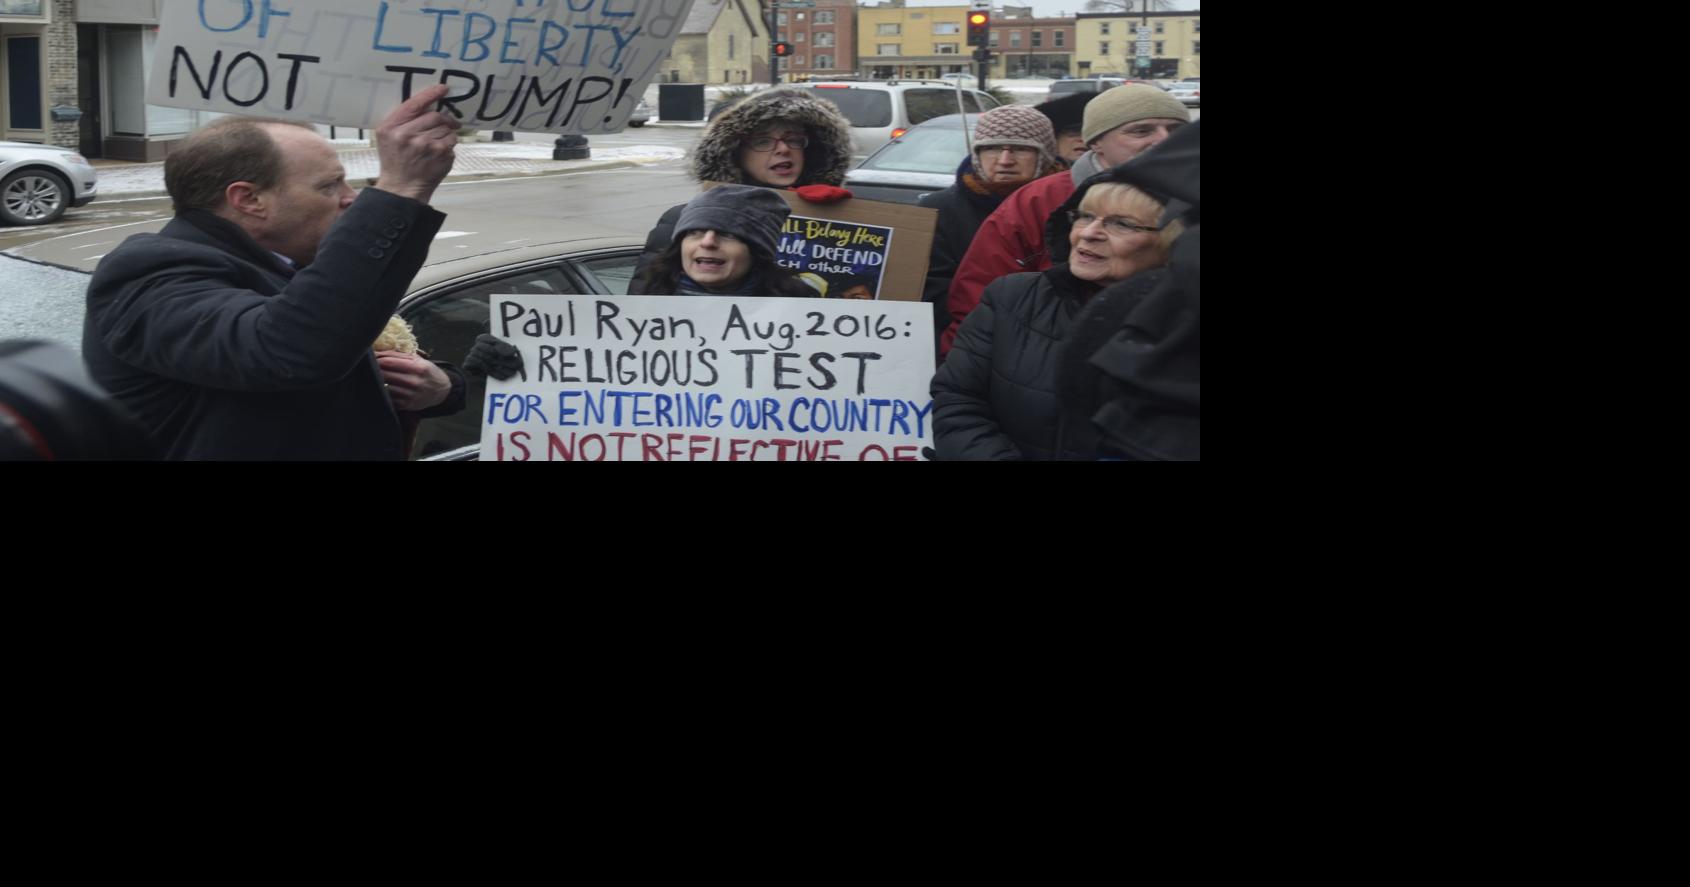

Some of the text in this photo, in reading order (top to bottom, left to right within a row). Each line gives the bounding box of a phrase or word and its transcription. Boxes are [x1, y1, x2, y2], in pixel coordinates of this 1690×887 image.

[169, 45, 320, 110] NOT
[385, 65, 633, 128] TRUMP!
[805, 220, 851, 246] Belong
[500, 300, 575, 338] Paul
[595, 300, 706, 347] Ryan,
[538, 345, 719, 387] RELIGIOUS
[730, 349, 882, 395] TEST
[487, 389, 933, 438] FOR ENTERING OUR COUNTRY
[497, 431, 531, 461] IS
[548, 431, 637, 461] NOT
